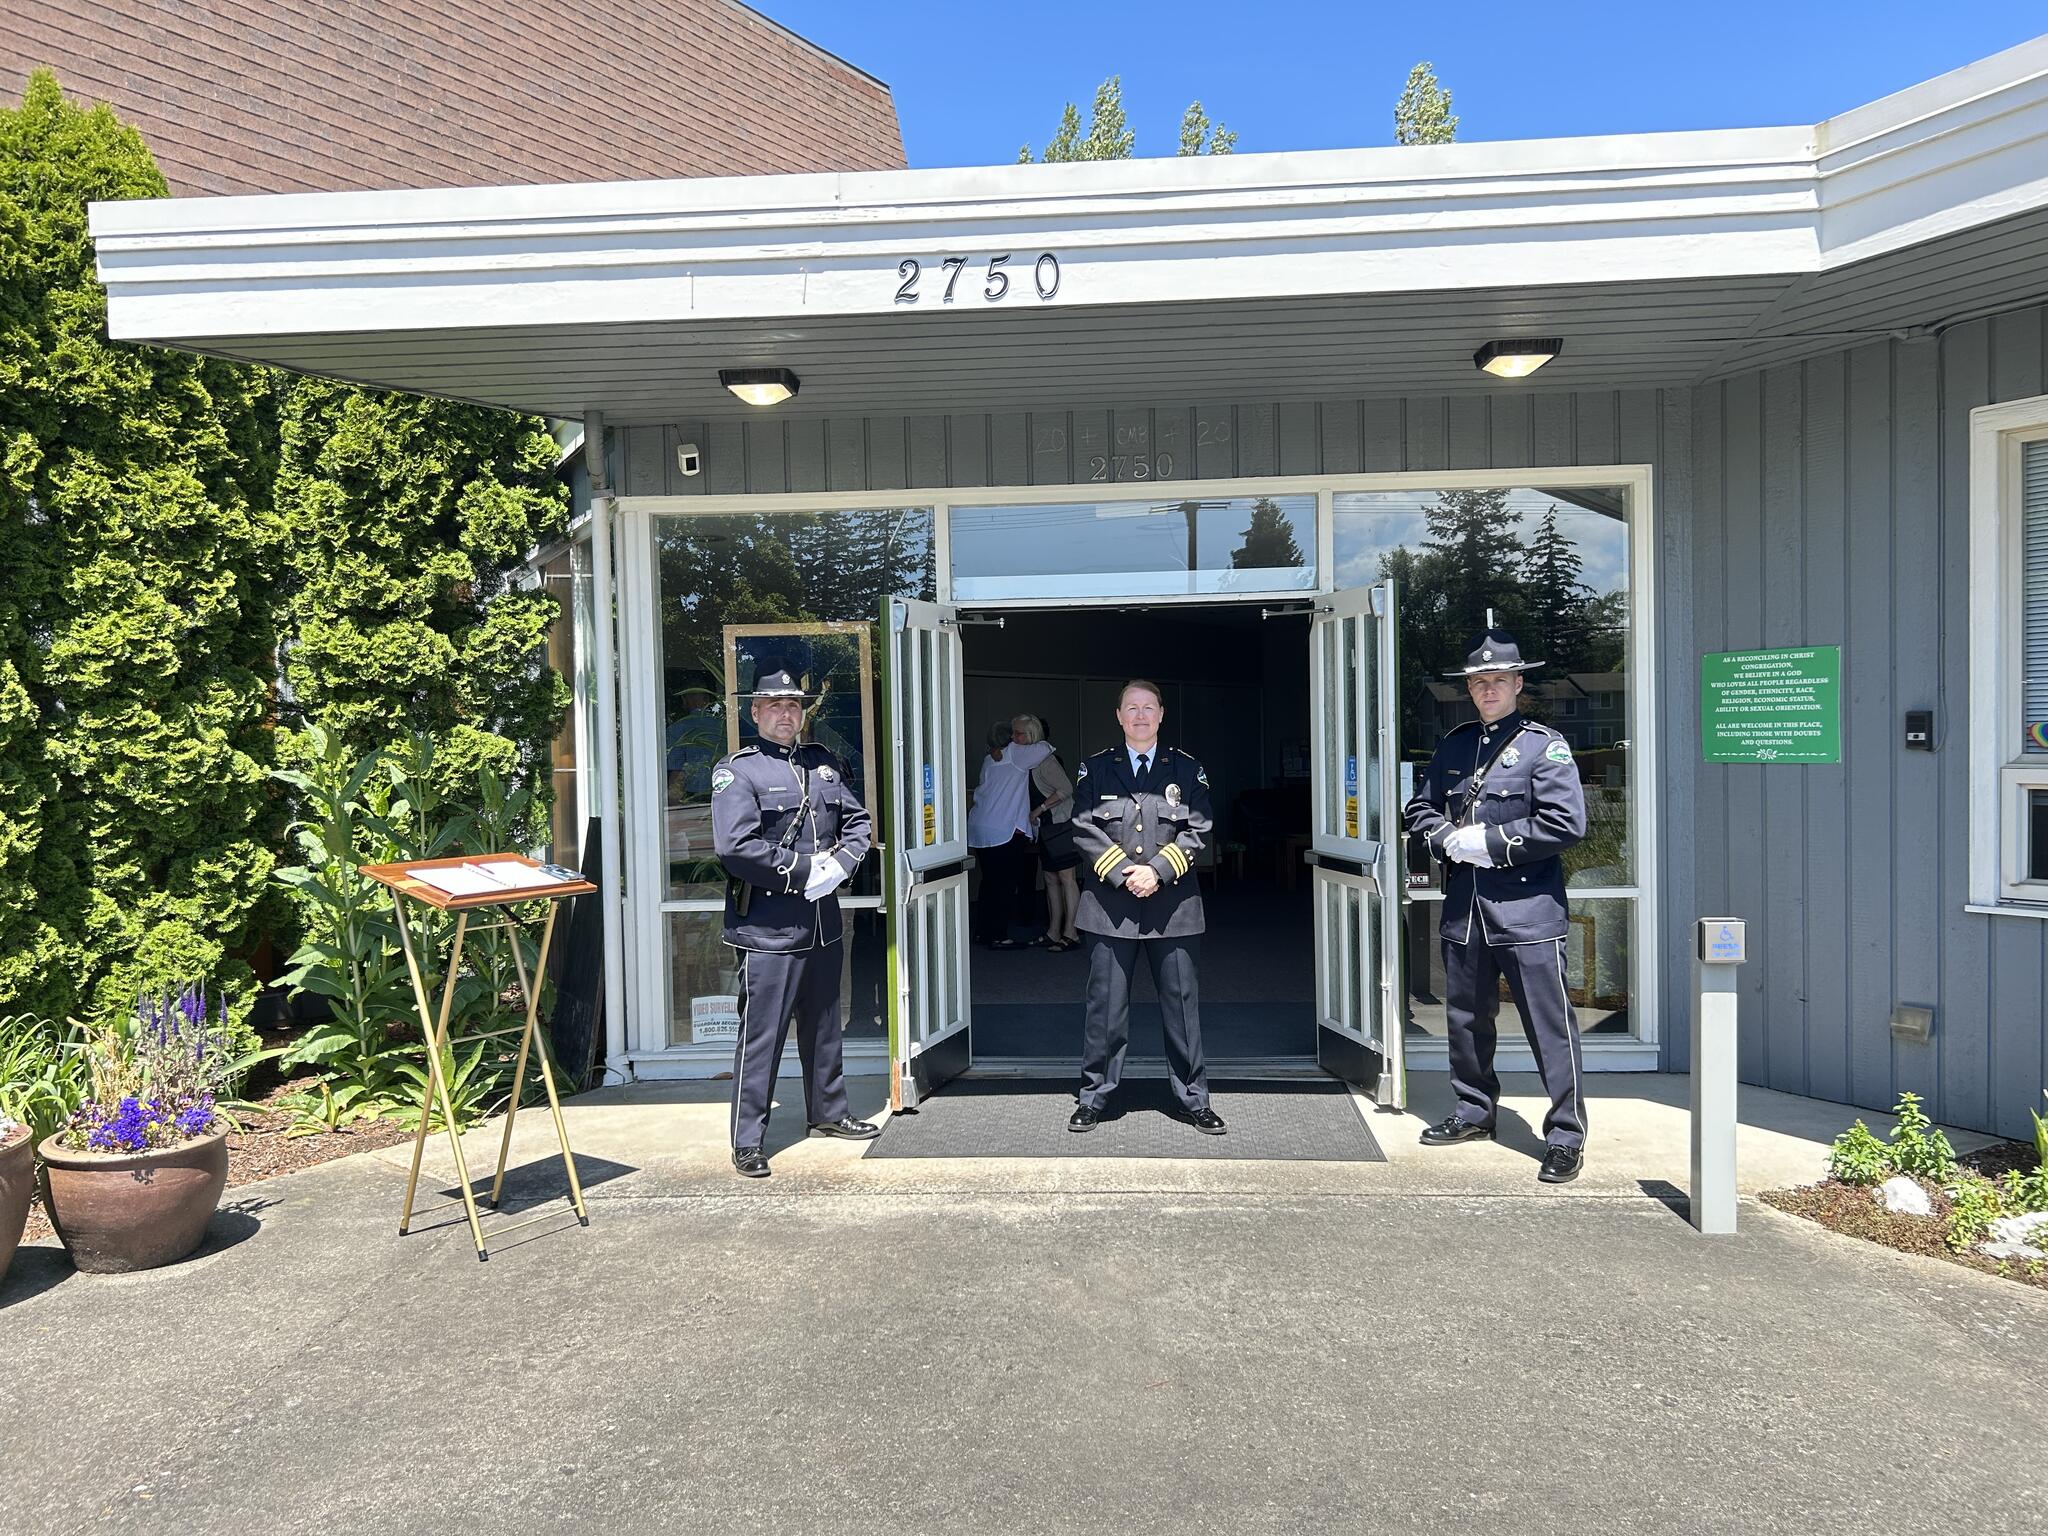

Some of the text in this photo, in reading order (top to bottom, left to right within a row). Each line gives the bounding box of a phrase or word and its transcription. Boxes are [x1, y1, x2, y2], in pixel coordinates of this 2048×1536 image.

[895, 252, 1060, 303] 2750
[1090, 452, 1173, 480] 2750
[1737, 654, 1780, 662] RECONCILING
[710, 1002, 737, 1014] SURVEILL
